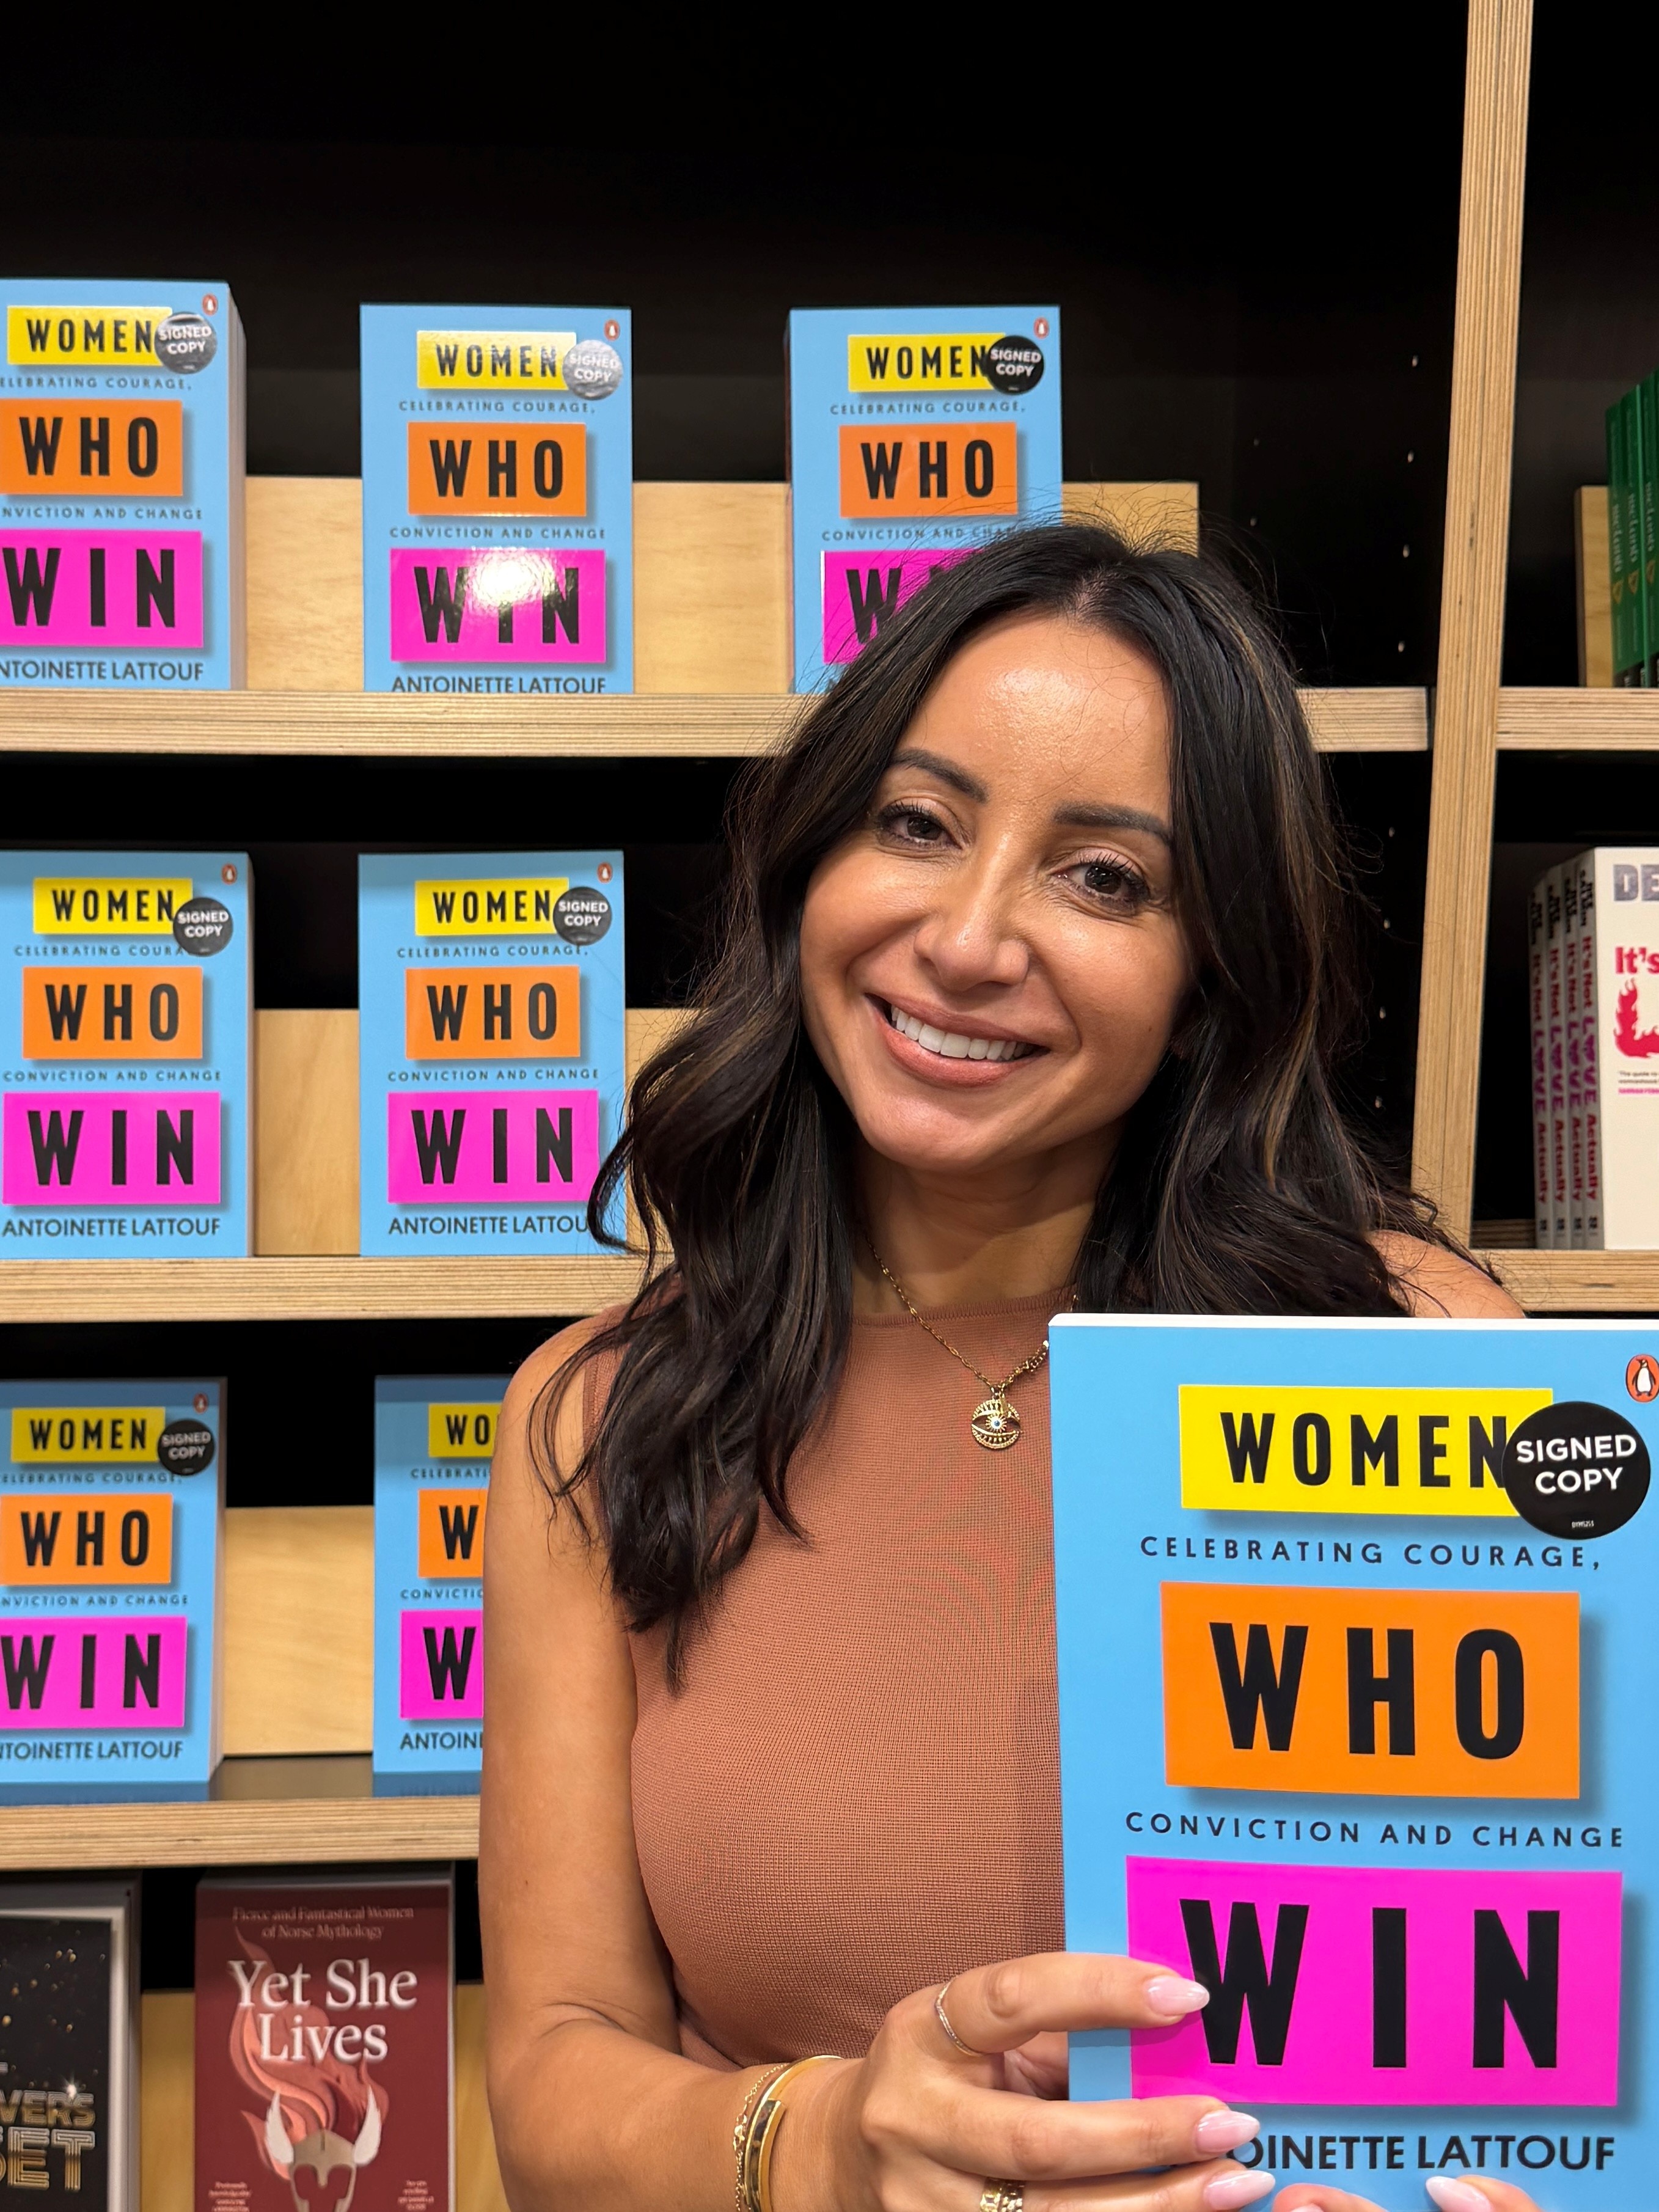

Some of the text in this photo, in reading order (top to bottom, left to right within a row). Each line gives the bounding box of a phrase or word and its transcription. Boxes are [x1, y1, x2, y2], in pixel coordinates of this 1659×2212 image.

[27, 319, 152, 353] WOMEN
[158, 324, 212, 340] SIGNED
[167, 340, 206, 355] COPY
[991, 349, 1042, 362] SIGNED
[436, 344, 557, 377] WOMEN
[569, 353, 619, 368] SIGNED
[866, 345, 988, 379] WOMEN
[996, 364, 1034, 376] COPY
[574, 368, 612, 383] COPY
[399, 400, 505, 412] CELEBRATING
[830, 403, 935, 415] CELEBRATING
[19, 417, 159, 477] WHO
[429, 439, 563, 499] WHO
[860, 439, 994, 499] WHO
[94, 508, 127, 519] AND
[135, 508, 202, 519] CHANGE
[389, 527, 606, 539] CONVICTION AND CHANGE
[822, 529, 924, 541] CONVICTION
[932, 529, 964, 539] AND
[2, 548, 175, 628] WIN
[112, 662, 203, 681] LATTOUF
[392, 676, 606, 693] ANTOINETTE LATTOUF
[51, 889, 174, 921] WOMEN
[433, 890, 550, 923] WOMEN
[558, 900, 609, 914] SIGNED
[177, 910, 229, 924] SIGNED
[564, 914, 602, 927] COPY
[184, 925, 223, 937] COPY
[14, 945, 121, 956] CELEBRATING
[128, 945, 186, 956] COURA
[397, 946, 499, 958] CELEBRATING
[1583, 972, 1592, 1008] Not
[45, 983, 180, 1041] WHO
[427, 983, 557, 1041] WHO
[2, 1071, 221, 1082] CONVICTION AND CHANGE
[388, 1069, 599, 1082] CONVICTION AND CHANGE
[27, 1110, 194, 1185] WIN
[411, 1107, 573, 1185] WIN
[1587, 1114, 1599, 1199] Actually
[2, 1218, 221, 1237] ANTOINETTE LATTOUF
[388, 1215, 588, 1234] ANTOINETTE LATTOU
[29, 1419, 147, 1451] WOMEN
[161, 1431, 211, 1446] SIGNED
[168, 1445, 205, 1459] COPY
[1221, 1412, 1507, 1489] WOMEN
[1516, 1435, 1636, 1463] SIGNED
[411, 1468, 486, 1479] CELEBRATI
[1535, 1467, 1623, 1495] COPY
[21, 1510, 149, 1567] WHO
[1140, 1537, 1601, 1571] CELEBRATING COURAGE,
[86, 1595, 118, 1606] AND
[125, 1594, 188, 1605] CHANGE
[400, 1589, 483, 1599] CONVICTI
[1, 1633, 161, 1710] WIN
[1209, 1622, 1526, 1760] WHO
[98, 1741, 182, 1759] LATTOUF
[400, 1732, 482, 1750] ANTOIN
[1125, 1812, 1624, 1848] CONVICTION AND CHANGE
[232, 1906, 414, 1921] Fierce and Fantastical Women
[262, 1924, 383, 1941] of Norse Mythology
[227, 1958, 417, 2010] Yet She
[1179, 1898, 1559, 2069] WIN
[257, 2013, 388, 2064] Lives
[0, 2126, 95, 2191] ET
[1226, 2135, 1614, 2170] OINETTE LATTOUF
